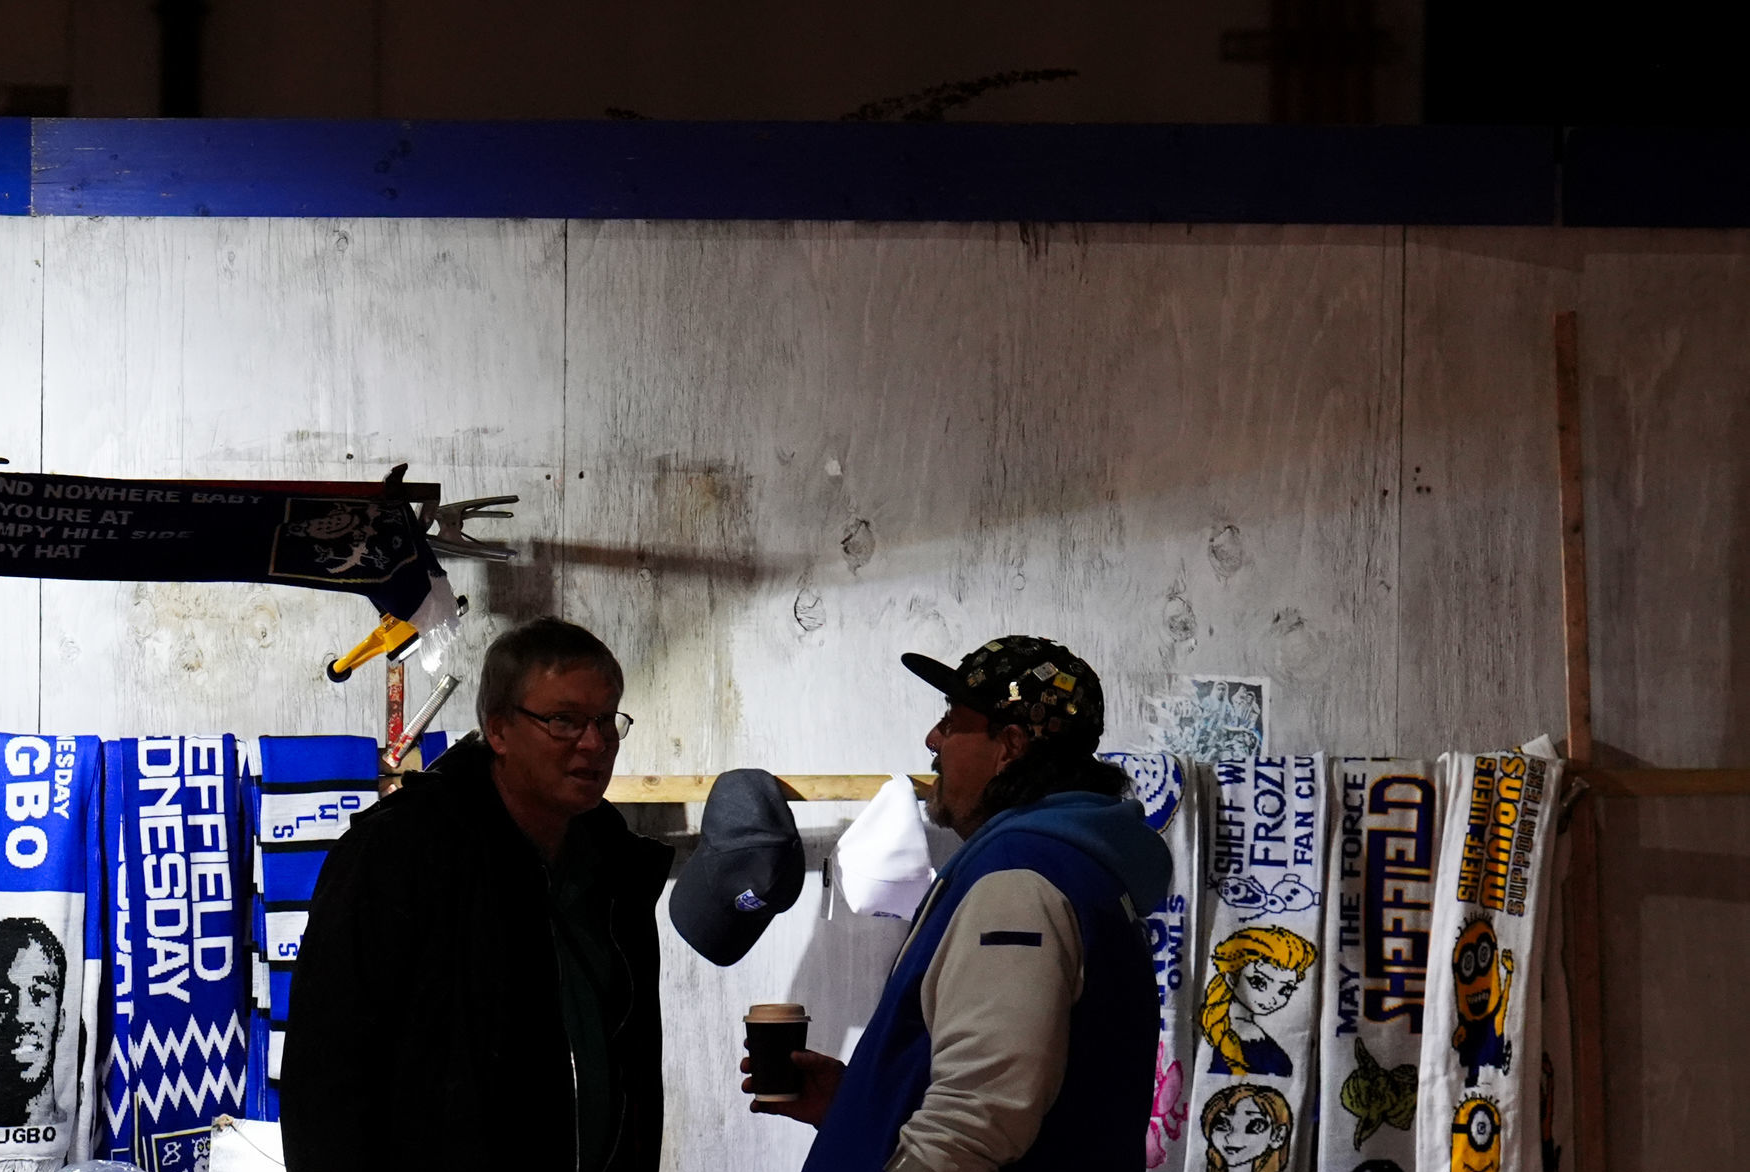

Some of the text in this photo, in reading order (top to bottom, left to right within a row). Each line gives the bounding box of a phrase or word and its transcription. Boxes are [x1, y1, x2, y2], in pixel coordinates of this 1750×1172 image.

[0, 502, 92, 524] YOURE
[98, 509, 134, 526] AT
[43, 483, 181, 504] NOWHERE
[34, 542, 87, 560] HAT
[61, 528, 120, 540] HILL
[129, 529, 195, 540] SIDE
[1213, 797, 1246, 875] SHEFF
[1294, 811, 1315, 866] FAN
[1341, 772, 1366, 880] FORCE
[1506, 759, 1547, 917] SUPPORTERS
[1457, 832, 1486, 903] SHEFF
[1340, 893, 1360, 952] THE
[1364, 775, 1436, 1035] SHEFFIELD
[1167, 894, 1185, 990] OWLS
[1336, 964, 1360, 1037] MAY
